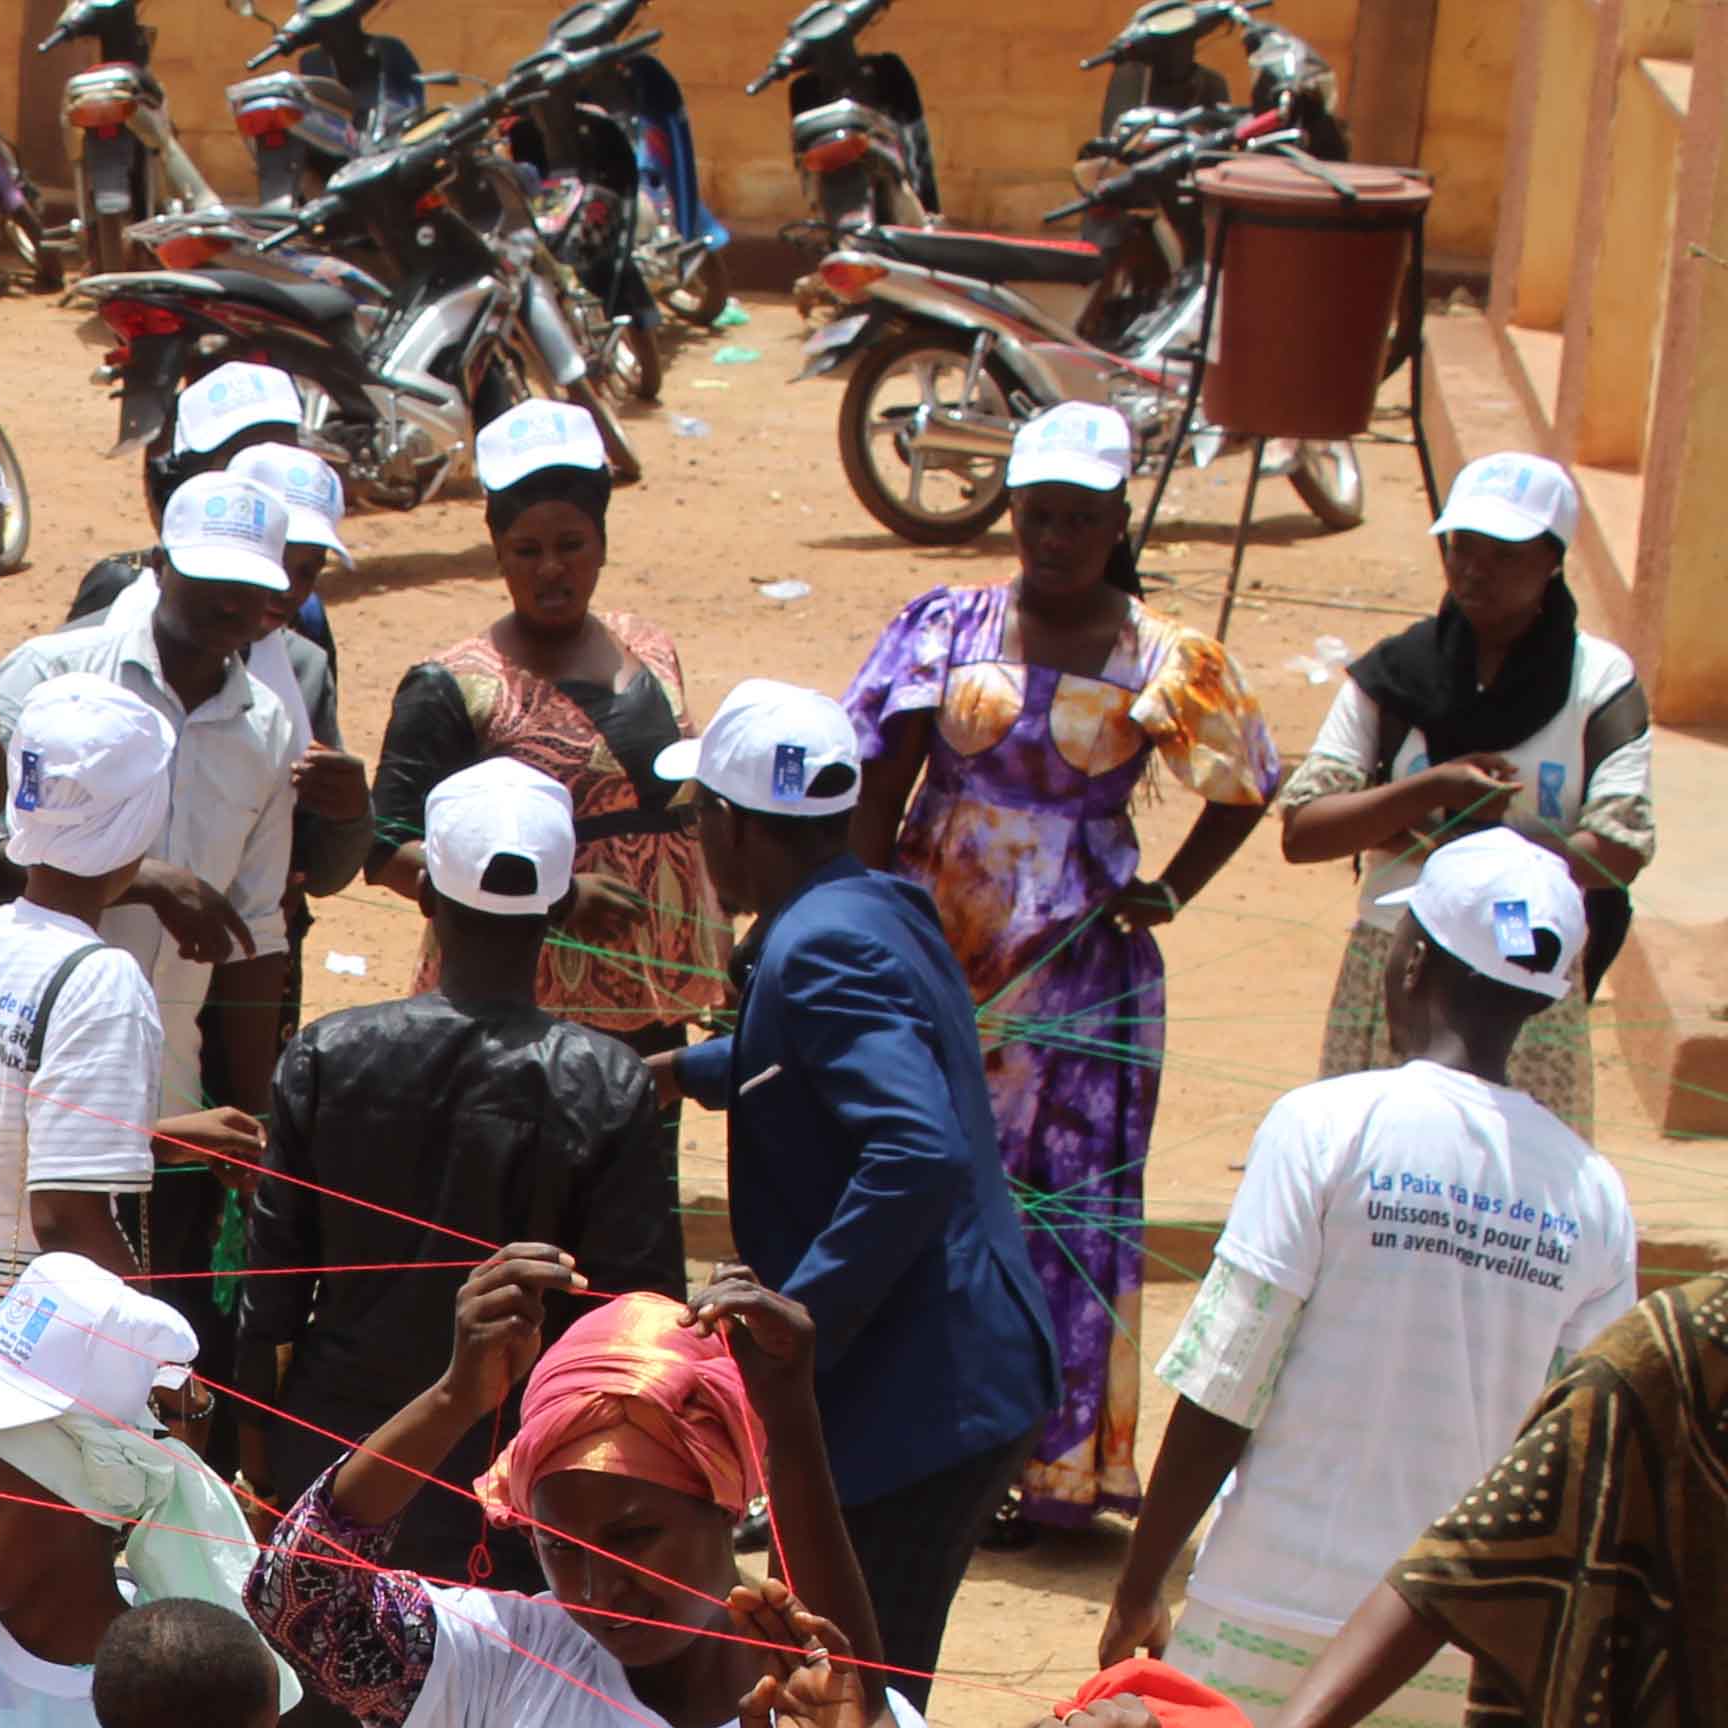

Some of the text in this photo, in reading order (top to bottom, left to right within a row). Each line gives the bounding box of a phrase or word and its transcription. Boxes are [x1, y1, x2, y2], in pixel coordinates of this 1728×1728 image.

[1368, 1169, 1393, 1192] La
[1401, 1172, 1442, 1197] Paix
[1509, 1200, 1536, 1224] de
[1367, 1200, 1451, 1228] Unissons
[1483, 1226, 1532, 1252] pour
[1371, 1231, 1398, 1248] un
